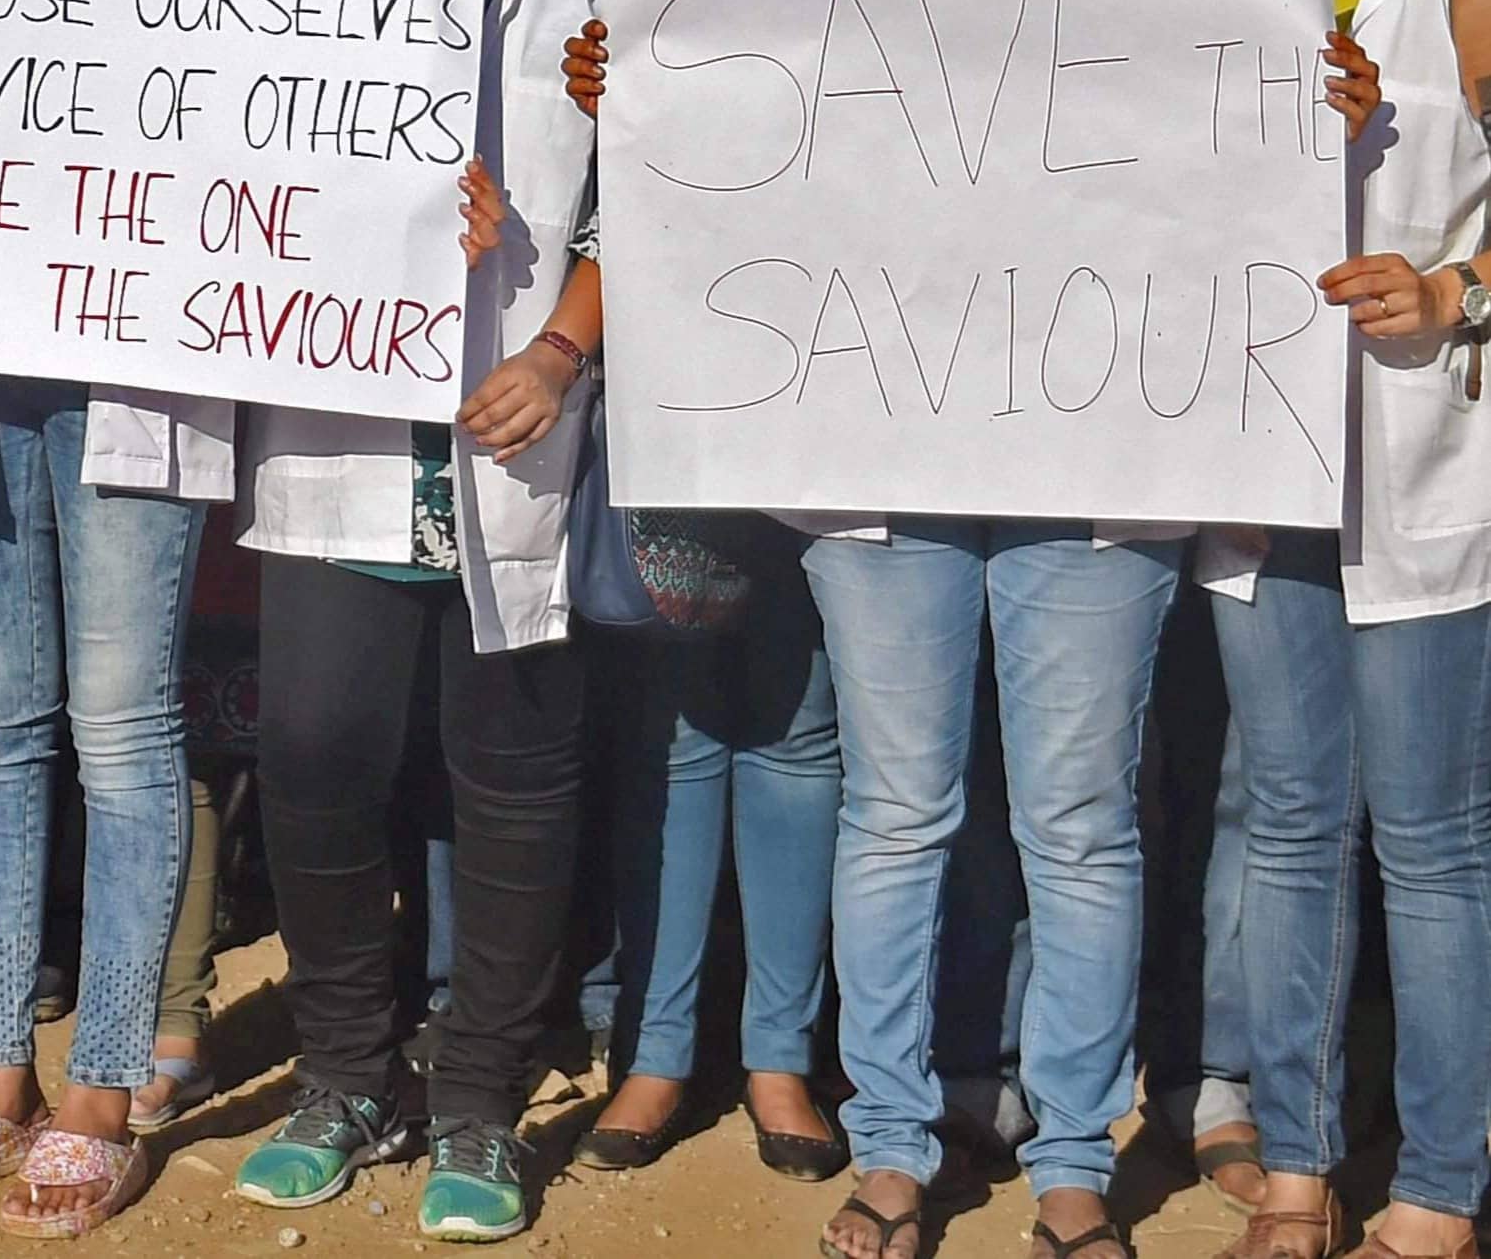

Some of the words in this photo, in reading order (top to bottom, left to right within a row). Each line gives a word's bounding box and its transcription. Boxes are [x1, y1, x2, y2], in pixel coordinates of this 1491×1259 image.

[138, 66, 215, 142] OF
[244, 73, 472, 166] OTHERS
[64, 163, 176, 247] THE
[200, 178, 321, 262] ONE
[48, 262, 150, 345] THE
[177, 279, 463, 383] SAVIOURS
[656, 256, 1335, 485] SAVIOUR
